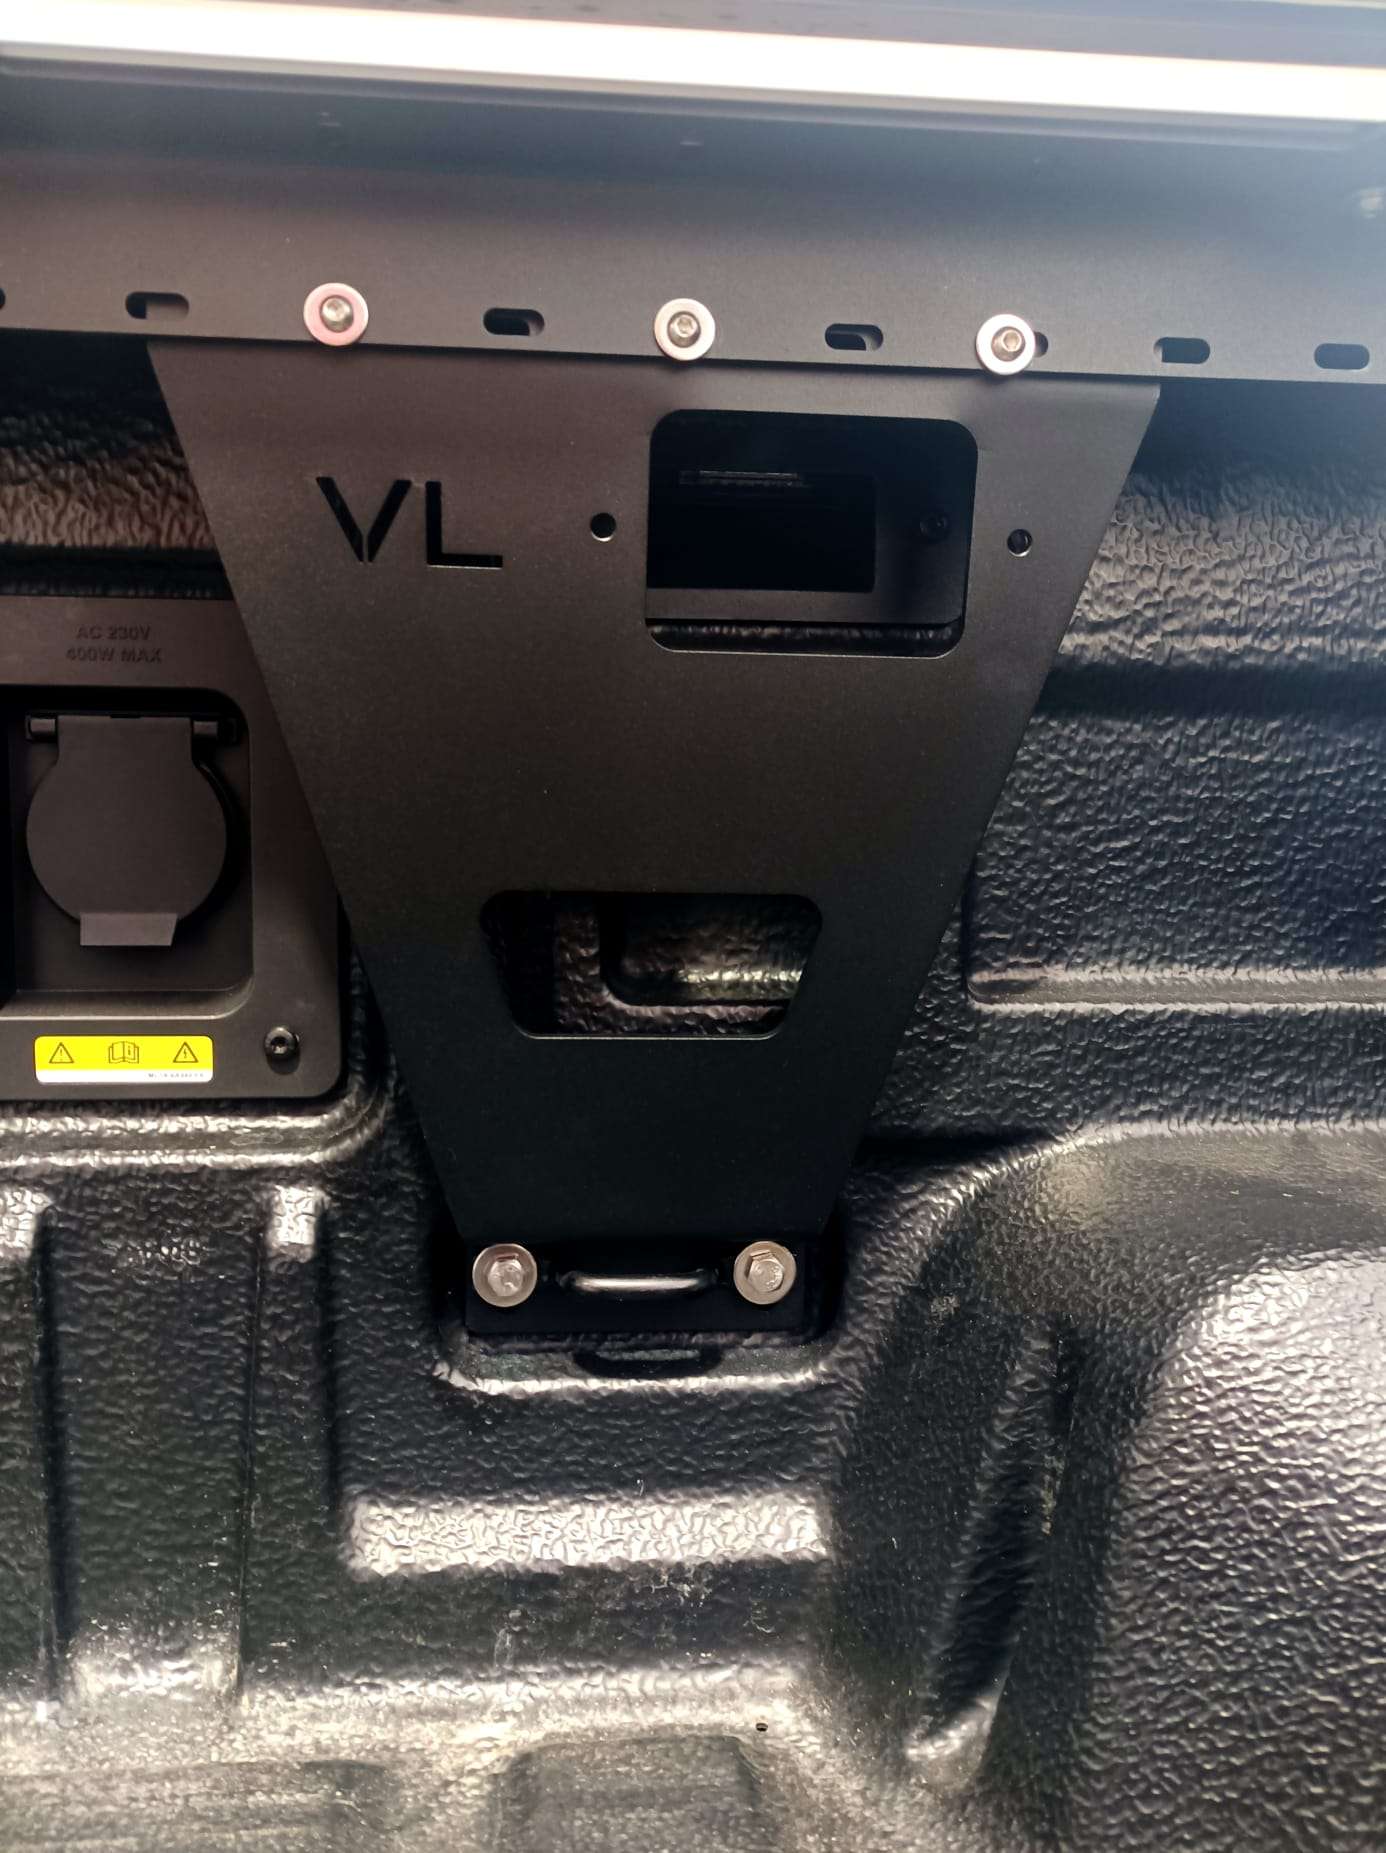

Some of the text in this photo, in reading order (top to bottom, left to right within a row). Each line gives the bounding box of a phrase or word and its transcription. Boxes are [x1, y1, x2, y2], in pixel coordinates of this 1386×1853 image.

[315, 476, 503, 569] VL
[76, 625, 151, 641] AC 230V
[66, 647, 162, 664] 400W MAX
